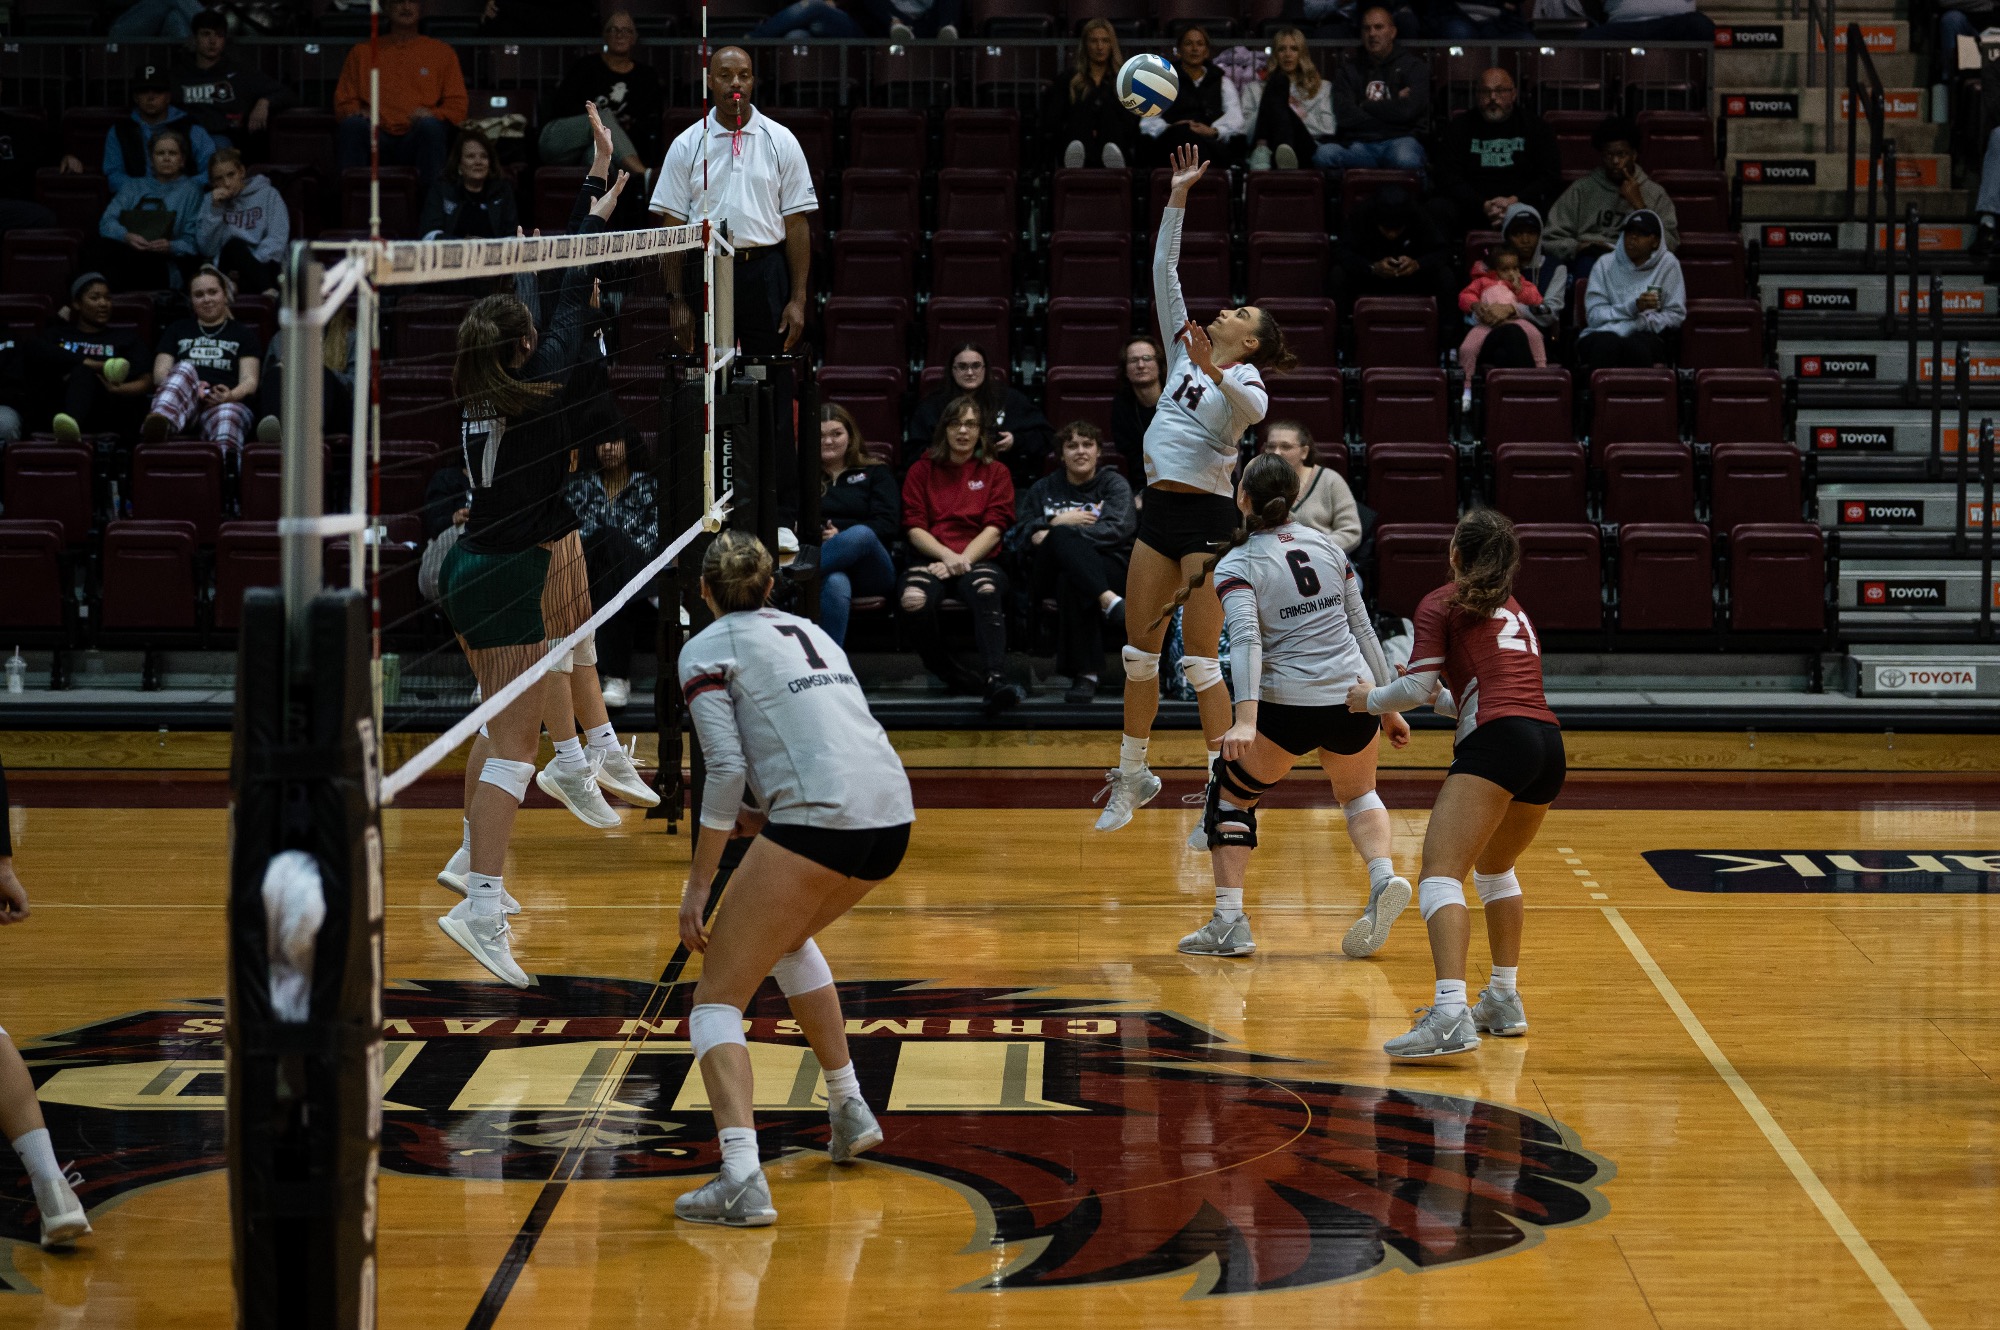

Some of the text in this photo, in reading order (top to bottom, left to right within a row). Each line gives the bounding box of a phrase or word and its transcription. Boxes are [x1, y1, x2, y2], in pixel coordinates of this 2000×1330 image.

[1735, 33, 1778, 42] TOYOTA
[145, 66, 156, 80] P
[181, 84, 216, 100] IUP
[1749, 101, 1792, 111] TOYOTA
[1764, 167, 1809, 178] TOYOTA
[1788, 232, 1832, 242] TOYOTA
[1806, 294, 1851, 305] TOYOTA
[1824, 361, 1870, 371] TOYOTA
[1171, 373, 1207, 411] 14
[1840, 433, 1887, 444] TOYOTA
[1868, 506, 1917, 518] TOYOTA
[1285, 549, 1321, 598] 6
[1888, 587, 1939, 599] TOYOTA
[1279, 594, 1343, 620] CRIMSON HAWKS
[1491, 607, 1540, 657] 21
[772, 624, 829, 670] 7
[788, 674, 835, 694] CRIMSON
[1909, 671, 1974, 684] TOYOTA
[617, 1019, 1117, 1035] CRIMSN
